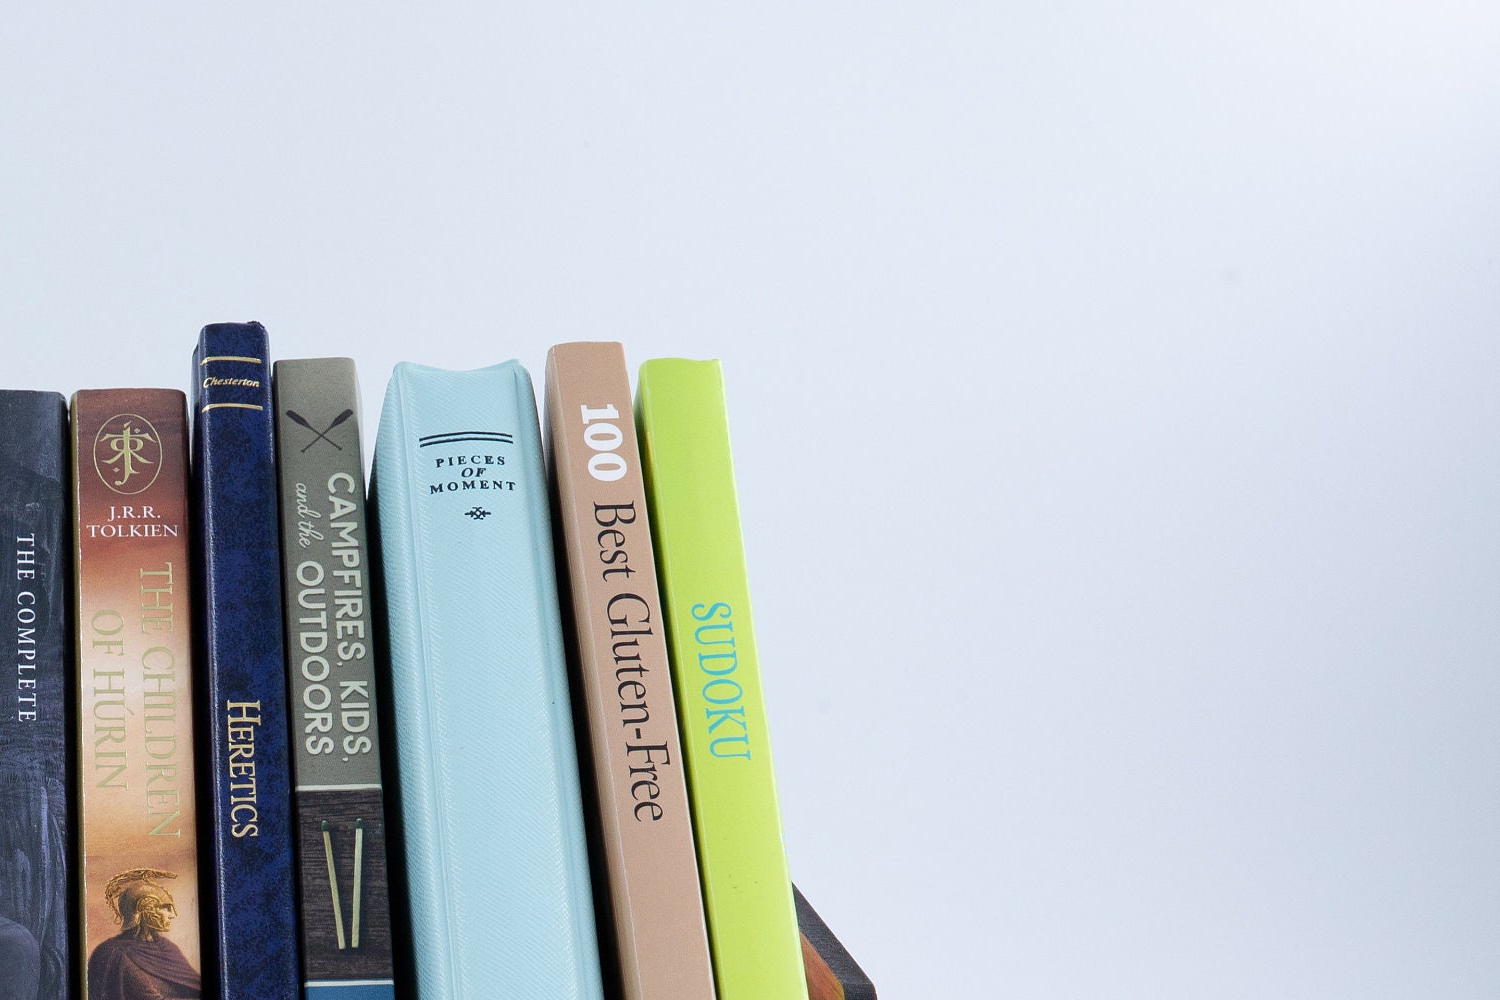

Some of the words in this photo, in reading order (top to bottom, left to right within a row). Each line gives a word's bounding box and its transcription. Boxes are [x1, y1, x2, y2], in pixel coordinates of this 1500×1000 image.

[203, 376, 260, 389] Chesterton
[436, 455, 505, 468] PIECES
[461, 468, 487, 478] OF
[580, 403, 628, 482] 100
[108, 505, 161, 521] J.R.R.
[295, 482, 322, 519] and
[430, 480, 516, 494] MOMENT
[16, 533, 35, 580] THE
[86, 524, 178, 537] TOLKIEN
[298, 518, 324, 549] the
[593, 500, 637, 582] Best
[140, 562, 174, 634] THE
[327, 471, 366, 667] CAMPFIRES,
[17, 591, 36, 722] COMPLETE
[91, 609, 125, 656] OF
[296, 560, 335, 755] OUTDOORS
[606, 592, 671, 822] Gluten-Free
[691, 602, 752, 761] SUDOKU
[93, 667, 135, 790] HÚRIN
[141, 646, 181, 838] CHILDREN
[339, 680, 372, 762] KIDS,
[227, 699, 262, 838] HERETICS
